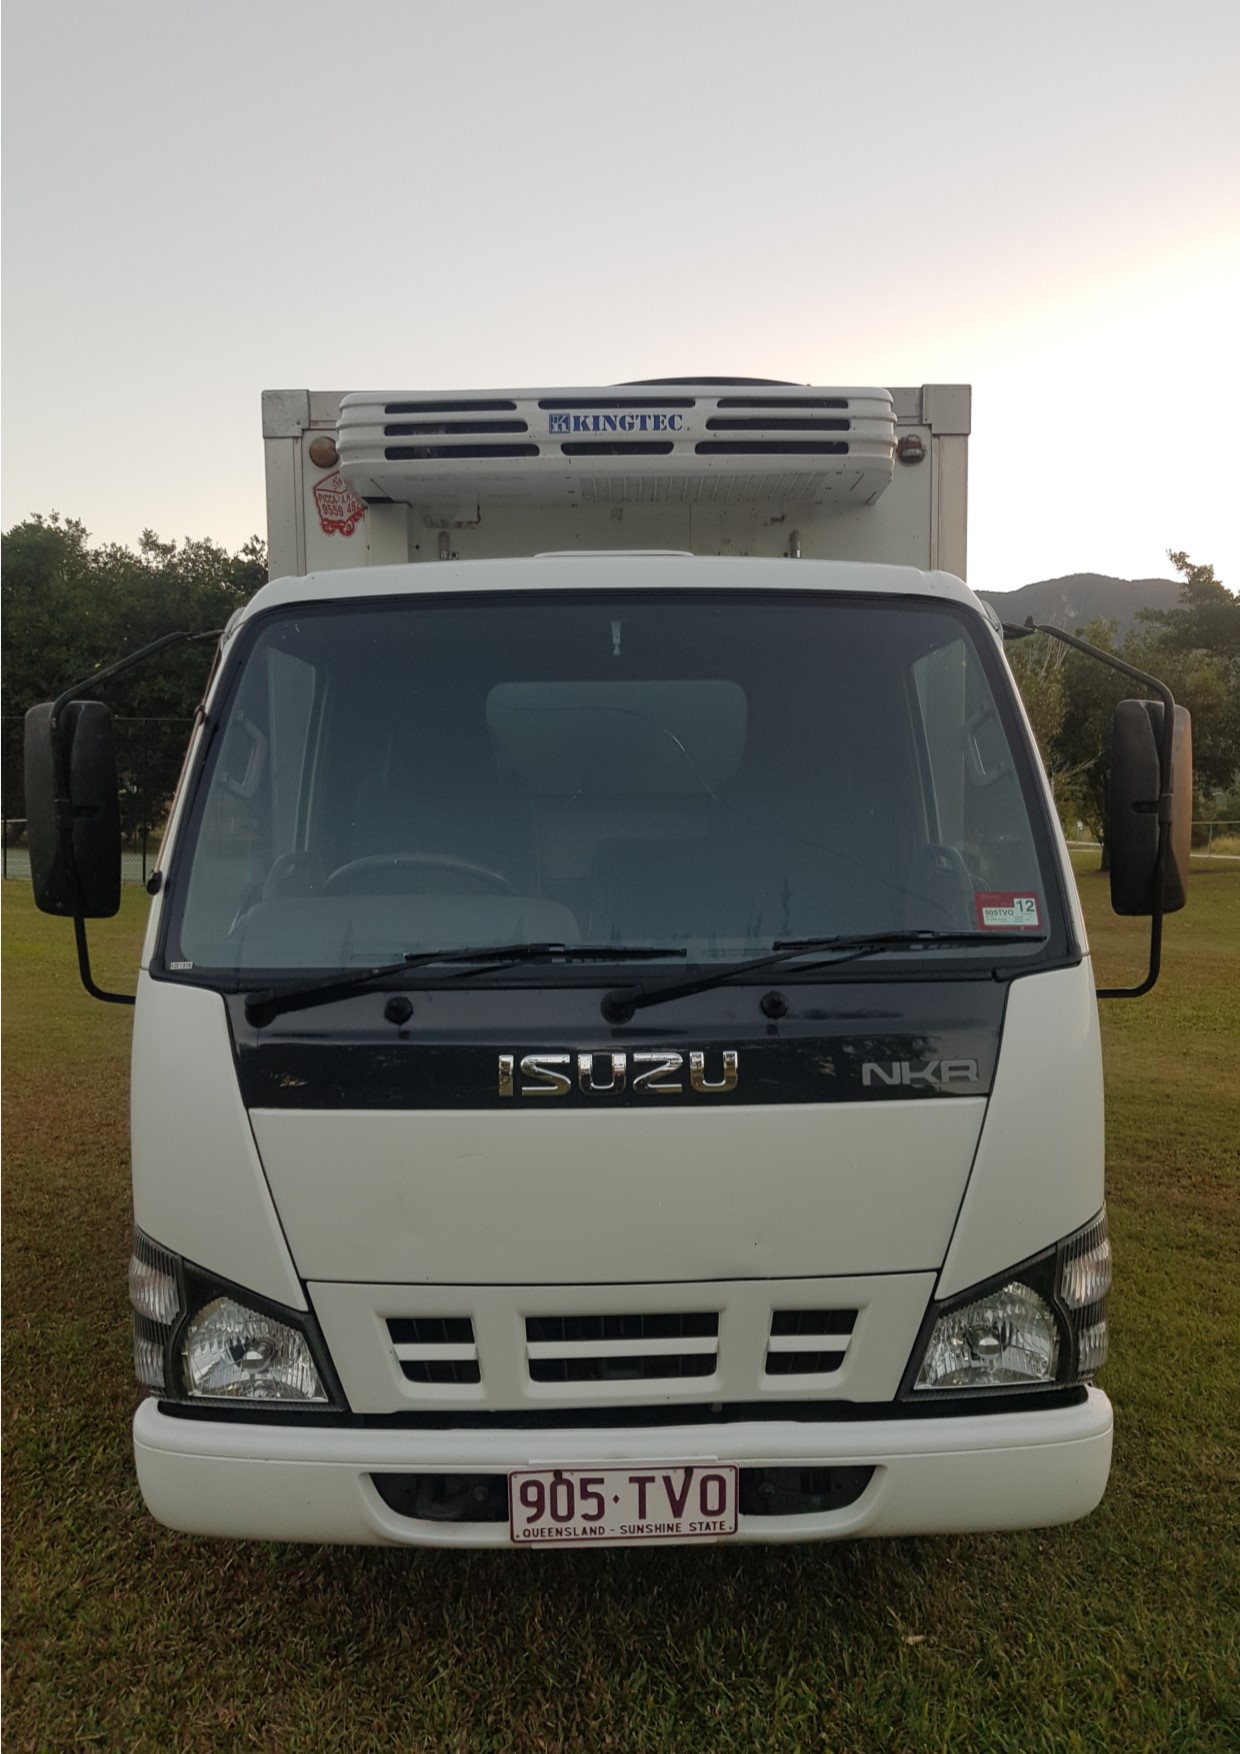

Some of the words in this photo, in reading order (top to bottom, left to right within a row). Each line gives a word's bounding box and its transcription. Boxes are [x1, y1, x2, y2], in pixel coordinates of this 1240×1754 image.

[572, 414, 683, 432] KINGTEC
[322, 503, 344, 517] 9559
[1016, 899, 1035, 913] 12
[498, 1050, 738, 1097] ISUZU
[862, 1058, 979, 1086] NKR
[522, 1526, 605, 1538] QUEENSLAND
[620, 1522, 682, 1534] SUNSHINE
[689, 1520, 726, 1532] STATE
